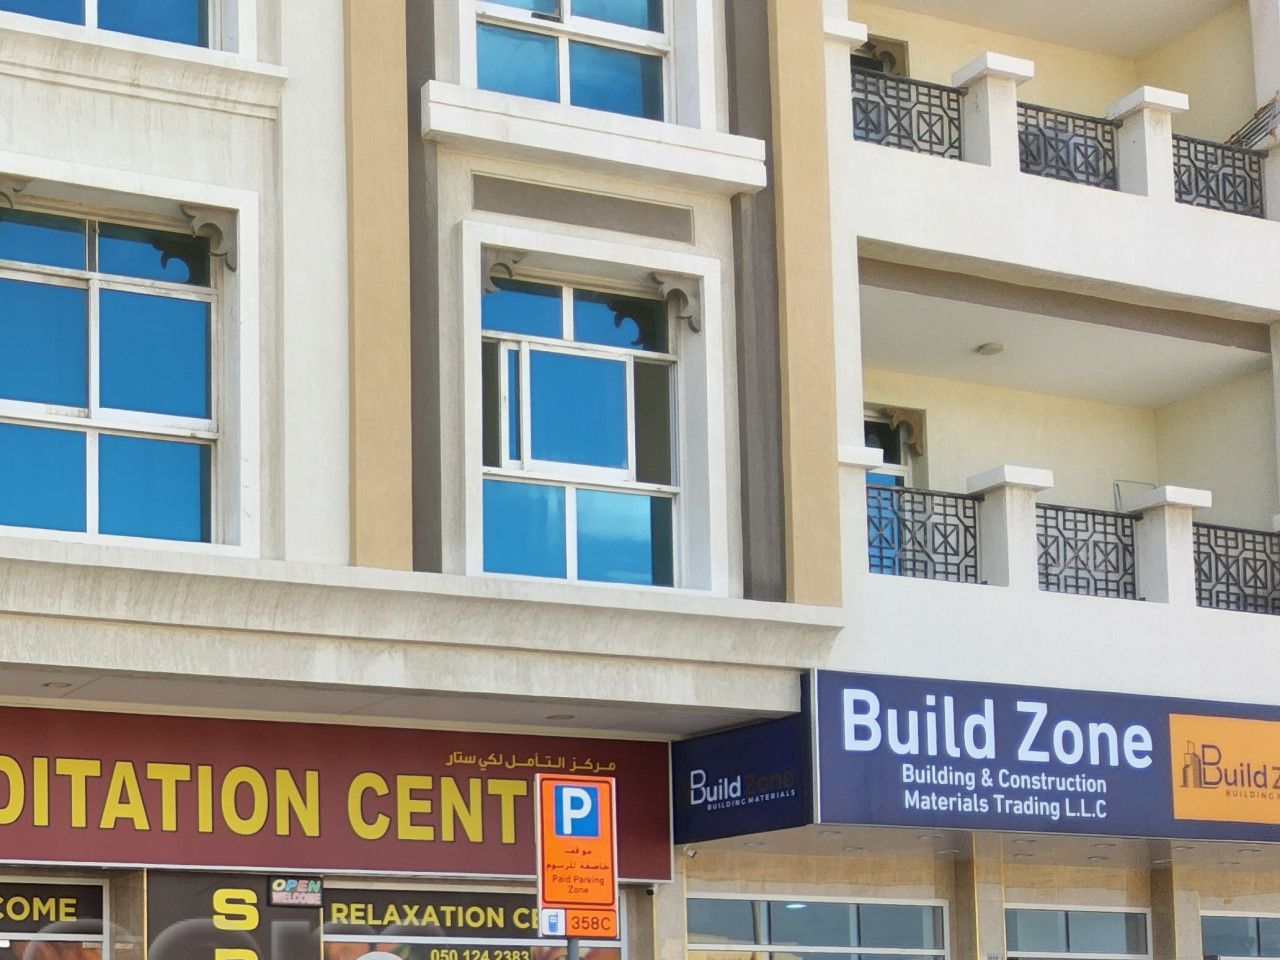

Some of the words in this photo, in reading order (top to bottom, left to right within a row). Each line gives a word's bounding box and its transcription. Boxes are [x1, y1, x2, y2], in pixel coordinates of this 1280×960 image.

[842, 688, 996, 760] Build
[1016, 700, 1154, 770] Zone
[446, 751, 476, 766] ستار
[1201, 744, 1267, 789] Build
[690, 769, 741, 805] Build
[902, 763, 976, 790] Building
[981, 767, 994, 788] &
[998, 768, 1108, 793] Construction
[748, 789, 797, 804] MATERIALS
[904, 790, 990, 813] Materials
[993, 794, 1061, 820] Trading
[1065, 797, 1108, 818] L.L.C
[1225, 789, 1275, 800] BUILDING
[562, 787, 592, 835] P
[272, 878, 322, 893] OPEN
[552, 874, 571, 883] Paid
[573, 875, 605, 886] Parking
[568, 885, 589, 894] Zone
[331, 902, 506, 930] RELAXATION
[571, 916, 611, 931] 358C
